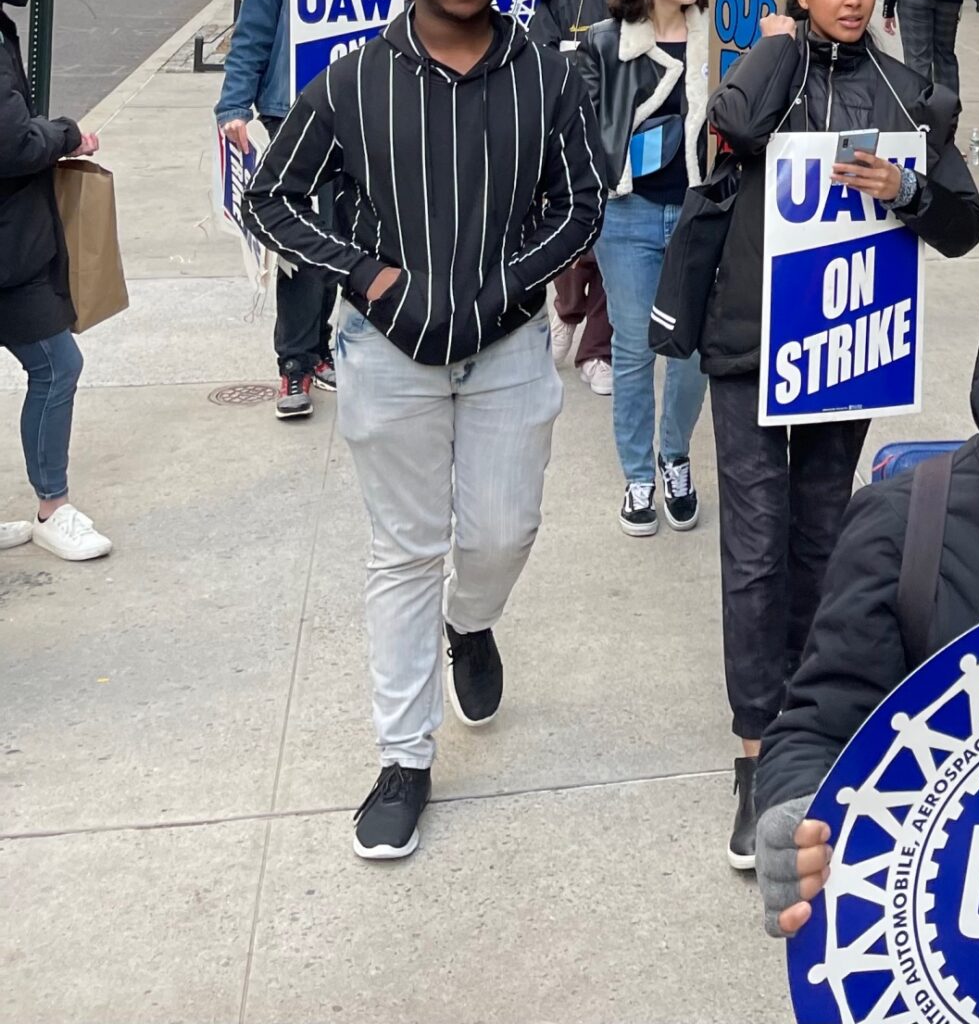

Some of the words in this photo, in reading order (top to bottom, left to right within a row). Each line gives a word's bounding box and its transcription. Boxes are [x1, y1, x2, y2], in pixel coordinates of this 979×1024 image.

[229, 141, 245, 228] TRIKE
[822, 246, 876, 320] ON
[774, 298, 912, 406] STRIKE
[893, 840, 921, 986] AUTOMOBILE,
